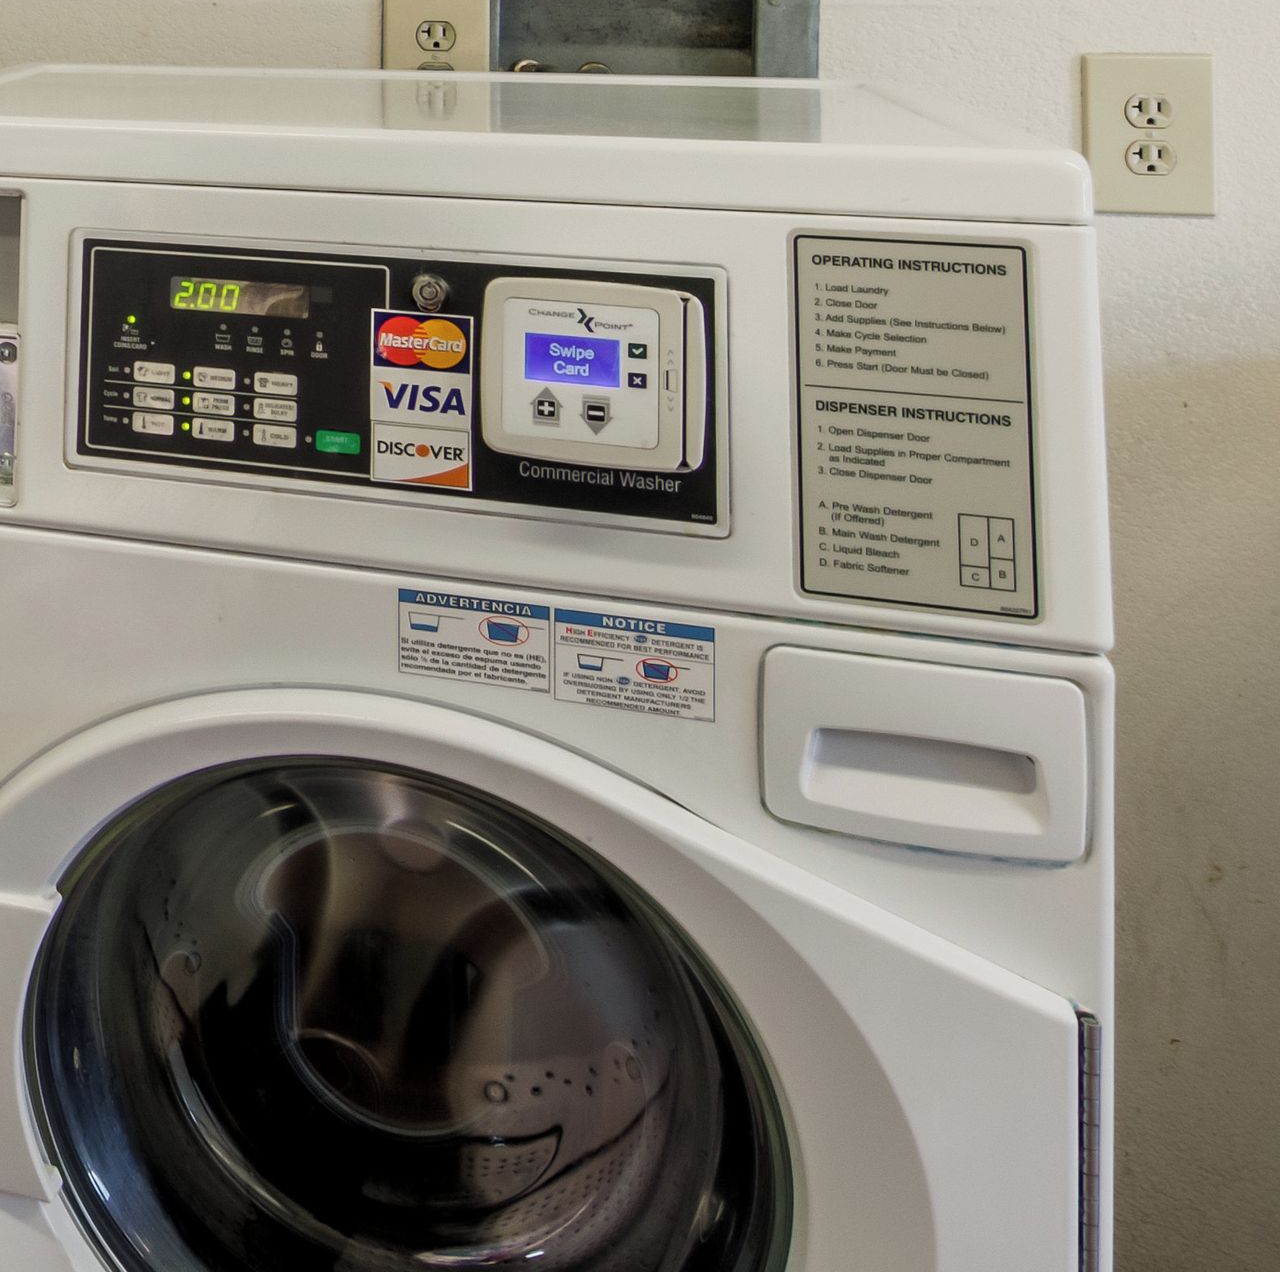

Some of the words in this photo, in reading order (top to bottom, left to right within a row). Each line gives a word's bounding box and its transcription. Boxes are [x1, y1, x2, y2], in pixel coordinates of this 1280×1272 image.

[812, 255, 893, 269] OPERATING
[898, 259, 1006, 276] INSTRUCTIONS
[174, 281, 239, 311] 2.00
[825, 284, 848, 293] Load
[851, 285, 888, 296] Laundry
[815, 298, 822, 306] 2.
[826, 299, 852, 308] Close
[855, 301, 877, 309] Door
[528, 309, 575, 320] CHANGE
[815, 313, 822, 321] 3.
[825, 314, 843, 323] Add
[847, 315, 887, 326] Supplies
[890, 318, 912, 328] (See
[915, 320, 969, 331] Instructions
[973, 323, 1005, 334] Below)
[380, 333, 463, 353] MasterCard
[827, 330, 852, 338] Make
[855, 331, 880, 341] Cycle
[883, 333, 926, 343] Selection
[549, 344, 594, 360] Swipe
[816, 344, 823, 352] 5.
[827, 345, 852, 353] Make
[855, 346, 896, 357] Payment
[554, 360, 589, 376] Card
[827, 360, 853, 369] Press
[857, 362, 878, 371] Start
[882, 364, 907, 374] (Door
[911, 366, 934, 375] Must
[937, 368, 948, 376] be
[952, 369, 989, 380] Closed)
[378, 382, 466, 416] VISA
[815, 400, 896, 417] DISPENSER
[902, 407, 1011, 426] INSTRUCTIONS
[270, 433, 288, 441] COLD
[829, 426, 853, 437] Open
[857, 429, 904, 441] Dispenser
[907, 433, 930, 442] Door
[377, 440, 465, 462] DISCOVER
[817, 443, 825, 451] 2.
[829, 444, 852, 453] Load
[855, 446, 895, 457] Supplies
[910, 451, 941, 462] Proper
[944, 453, 1010, 468] Compartment
[843, 455, 885, 467] Indicated
[519, 461, 614, 486] Commercial
[620, 474, 681, 493] Washer
[829, 468, 856, 477] Close
[859, 470, 906, 483] Dispenser
[910, 475, 932, 484] Door
[819, 501, 827, 509] A.
[832, 502, 849, 511] Pre
[852, 504, 880, 514] Wash
[883, 506, 932, 519] Detergent
[831, 513, 842, 522] (If
[845, 515, 884, 526] Offered)
[819, 527, 827, 535] B.
[832, 528, 855, 538] Main
[859, 531, 887, 540] Wash
[890, 533, 939, 547] Detergent
[970, 538, 979, 547] D
[997, 534, 1005, 542] A
[819, 542, 829, 551] C.
[833, 544, 862, 555] Liquid
[866, 547, 900, 559] Bleach
[820, 558, 829, 567] D.
[834, 560, 864, 571] Fabric
[868, 562, 909, 575] Softener
[999, 570, 1006, 578] B
[971, 573, 980, 581] C
[416, 593, 531, 616] ADVERTENCIA
[603, 616, 666, 634] NOTICE
